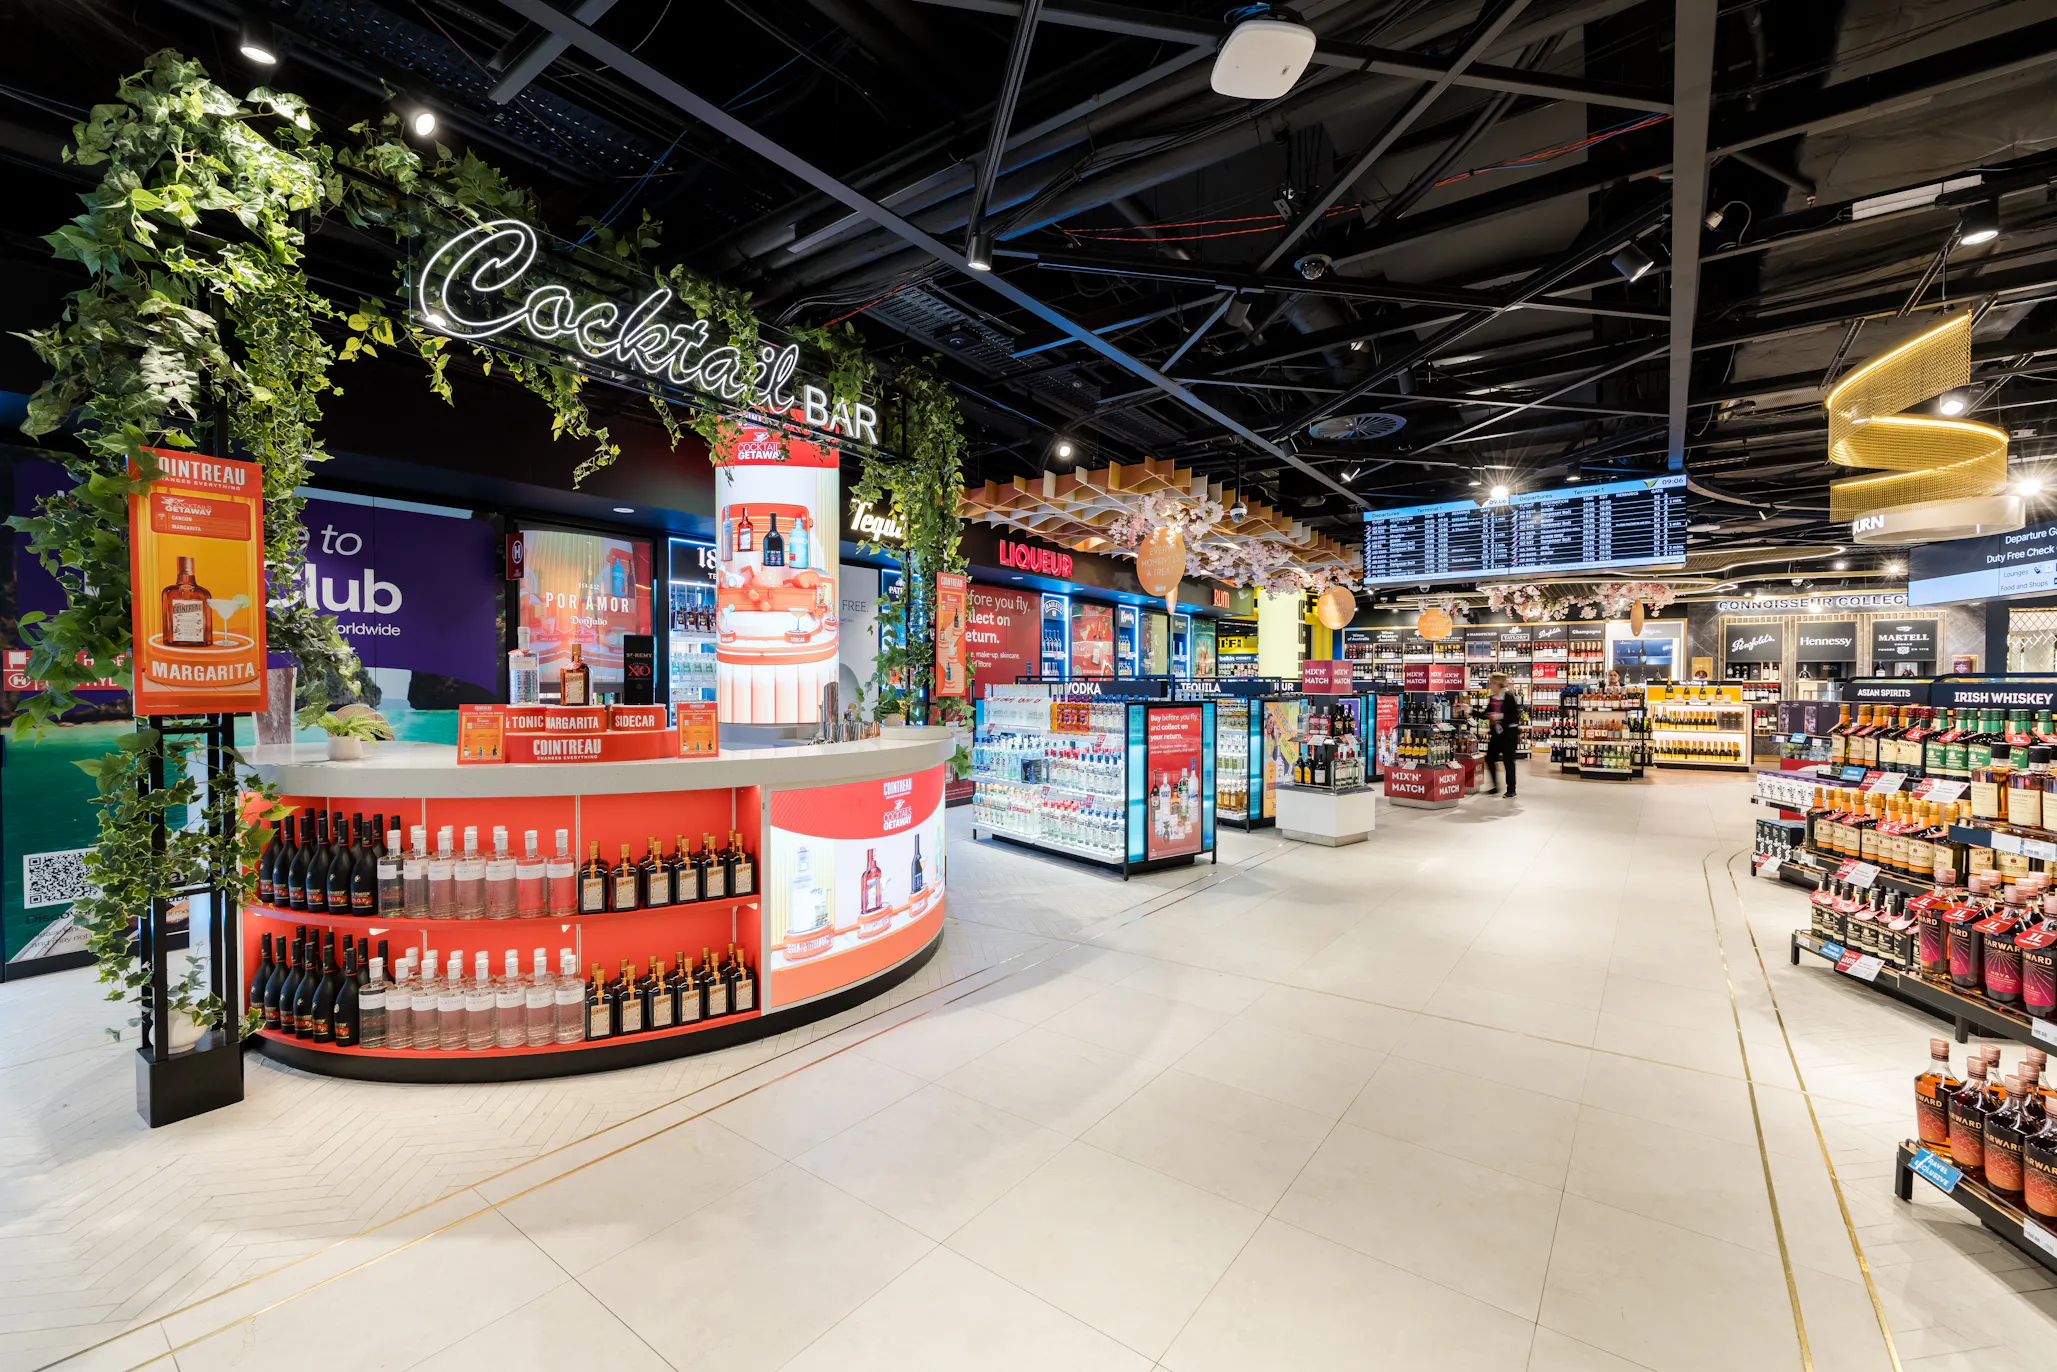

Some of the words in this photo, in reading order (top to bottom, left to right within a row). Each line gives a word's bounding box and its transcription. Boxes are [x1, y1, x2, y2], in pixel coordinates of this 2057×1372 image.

[419, 219, 800, 415] Cocktail
[803, 384, 878, 445] BAR
[158, 457, 245, 486] OINTREAU
[161, 477, 191, 485] ANGES
[194, 481, 240, 491] EVERYTHING
[165, 506, 212, 516] GETAWAY
[171, 524, 201, 532] MARGARITA
[321, 524, 363, 555] to
[2005, 530, 2047, 544] Departure
[1000, 539, 1073, 578] LIQUEUR
[1987, 554, 2006, 563] Duty
[2007, 551, 2025, 560] Free
[2027, 545, 2055, 556] Check
[2003, 569, 2029, 578] Lounges
[2029, 580, 2048, 588] Shops
[546, 592, 577, 609] POR
[586, 596, 630, 612] AMOR
[967, 589, 993, 606] fore
[995, 597, 1014, 611] you
[1016, 596, 1031, 614] fly,
[1213, 588, 1230, 608] RUM
[1718, 596, 1832, 610] CONNOISSEUR
[842, 599, 869, 613] FREE.
[968, 609, 995, 625] llect
[997, 615, 1010, 626] on
[965, 629, 1000, 643] eturn.
[1800, 637, 1852, 647] Hennessy
[152, 661, 255, 681] MARGARITA
[628, 665, 651, 676] XO
[1181, 683, 1221, 693] TEQUILA
[1857, 689, 1879, 697] ASIAN
[1880, 689, 1911, 698] SPIRITS
[1954, 691, 1987, 703] IRISH
[1990, 691, 2053, 705] WHISKEY
[512, 716, 544, 728] TONIC
[615, 715, 655, 727] SIDECAR
[1150, 714, 1161, 723] Buy
[1162, 713, 1179, 721] before
[1180, 714, 1190, 722] you
[1150, 734, 1163, 742] your
[533, 739, 602, 756] COINTREAU
[1391, 771, 1421, 781] MIX'N'
[1439, 773, 1457, 784] MIX'N'
[1391, 783, 1425, 793] MATCH
[1439, 785, 1460, 795] MATCH
[2026, 933, 2044, 942] 1L
[1913, 1160, 1949, 1187] ECLUSIVE
